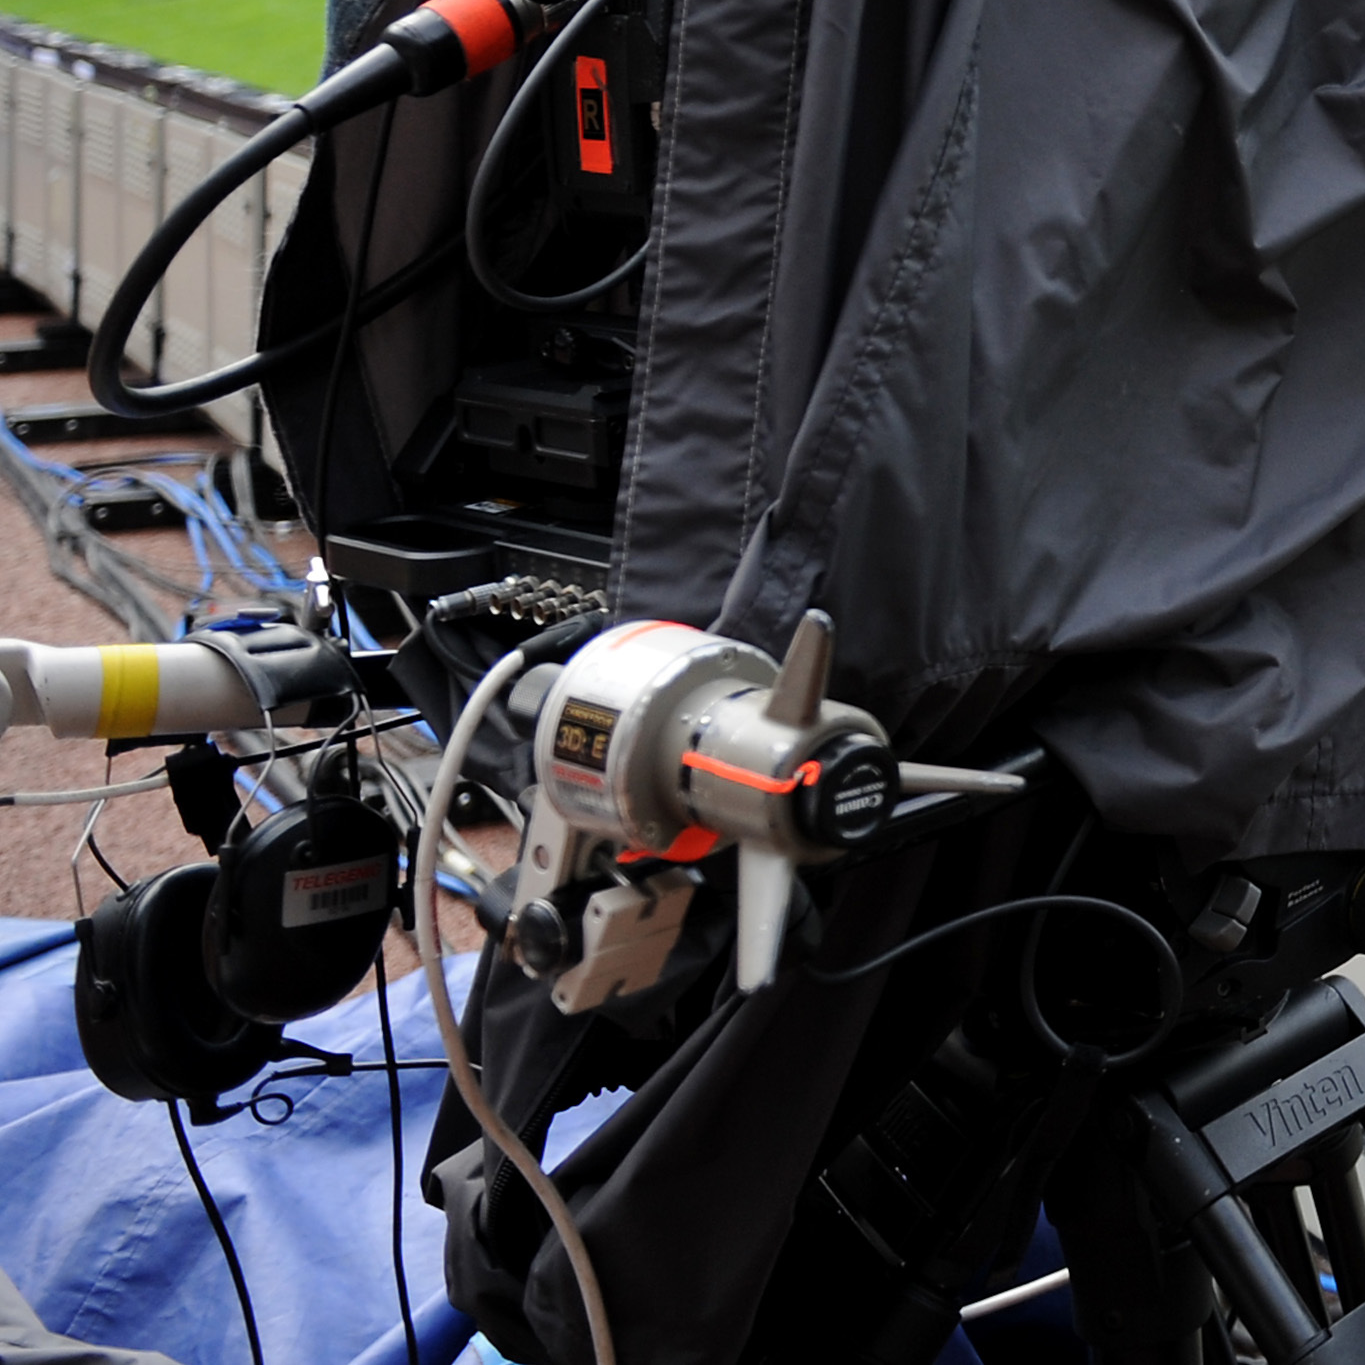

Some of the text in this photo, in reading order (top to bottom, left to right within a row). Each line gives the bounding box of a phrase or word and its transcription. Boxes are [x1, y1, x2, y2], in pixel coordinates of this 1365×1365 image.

[583, 99, 600, 131] R
[835, 793, 884, 815] Canon
[1244, 1065, 1364, 1146] Vinten
